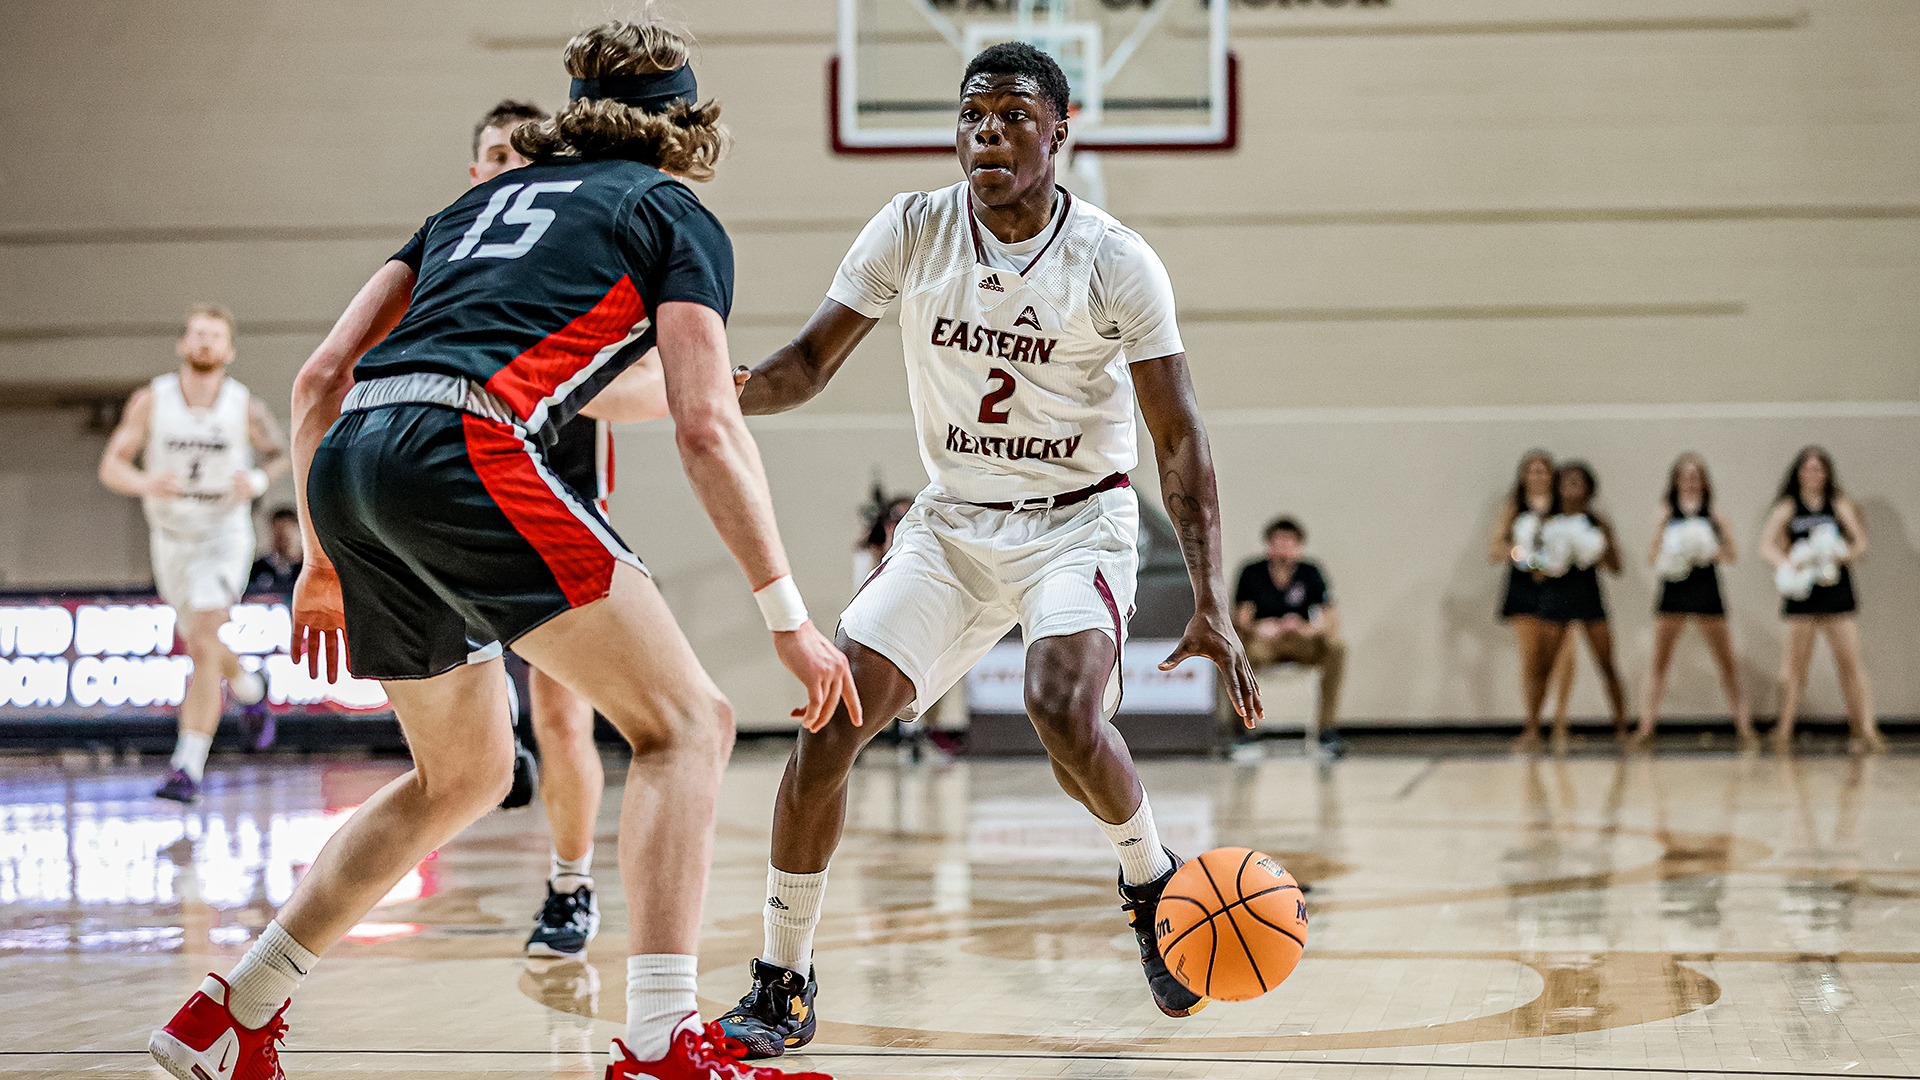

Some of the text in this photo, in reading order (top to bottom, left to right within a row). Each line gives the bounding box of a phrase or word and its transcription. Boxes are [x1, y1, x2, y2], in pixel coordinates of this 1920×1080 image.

[448, 180, 583, 262] 15
[978, 282, 1005, 293] adidas
[931, 316, 1059, 365] EASTERN
[979, 368, 1016, 424] 2
[946, 422, 1083, 460] KENTUCKY
